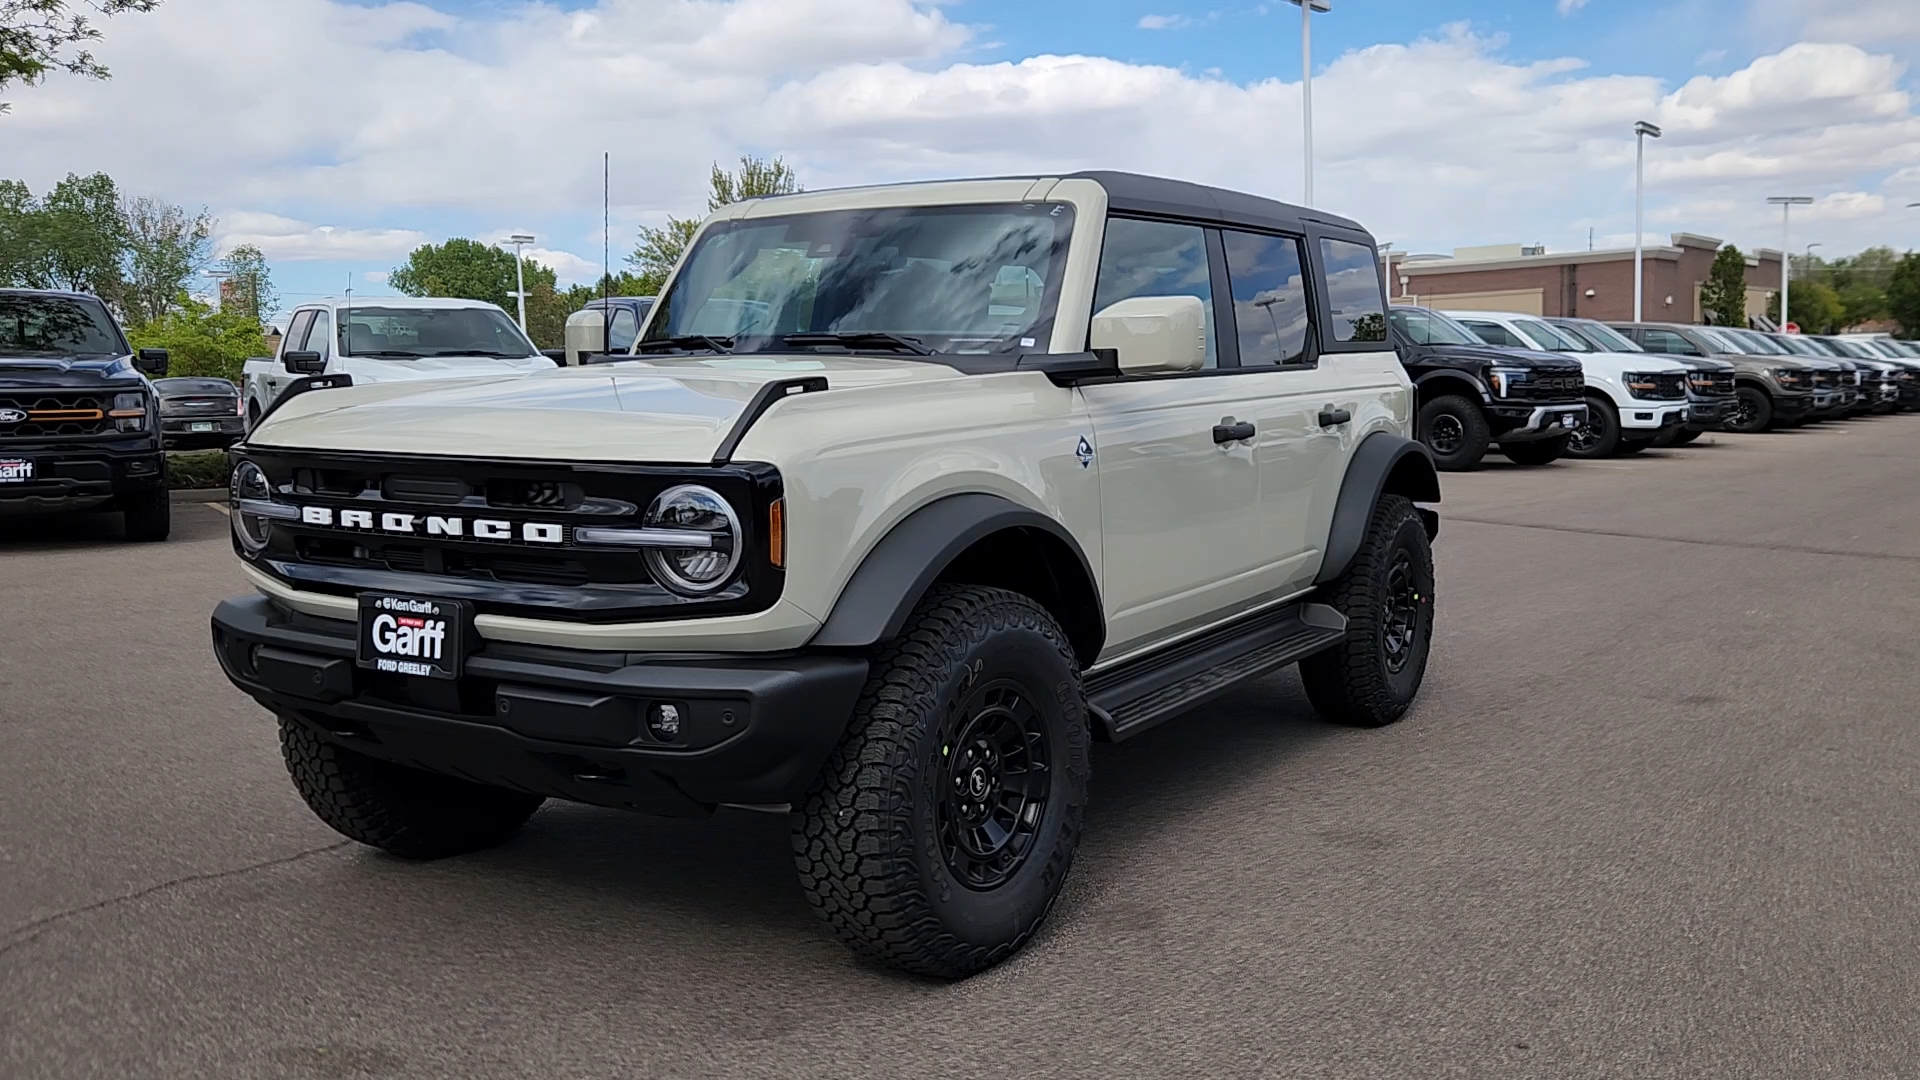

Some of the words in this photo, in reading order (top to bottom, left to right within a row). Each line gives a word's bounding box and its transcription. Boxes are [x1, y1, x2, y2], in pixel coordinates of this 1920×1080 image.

[0, 463, 33, 478] arff
[302, 506, 563, 543] BRONCO
[409, 600, 432, 614] Garff
[372, 614, 445, 658] Garff
[377, 660, 397, 671] FORD
[398, 662, 431, 676] GREELEY
